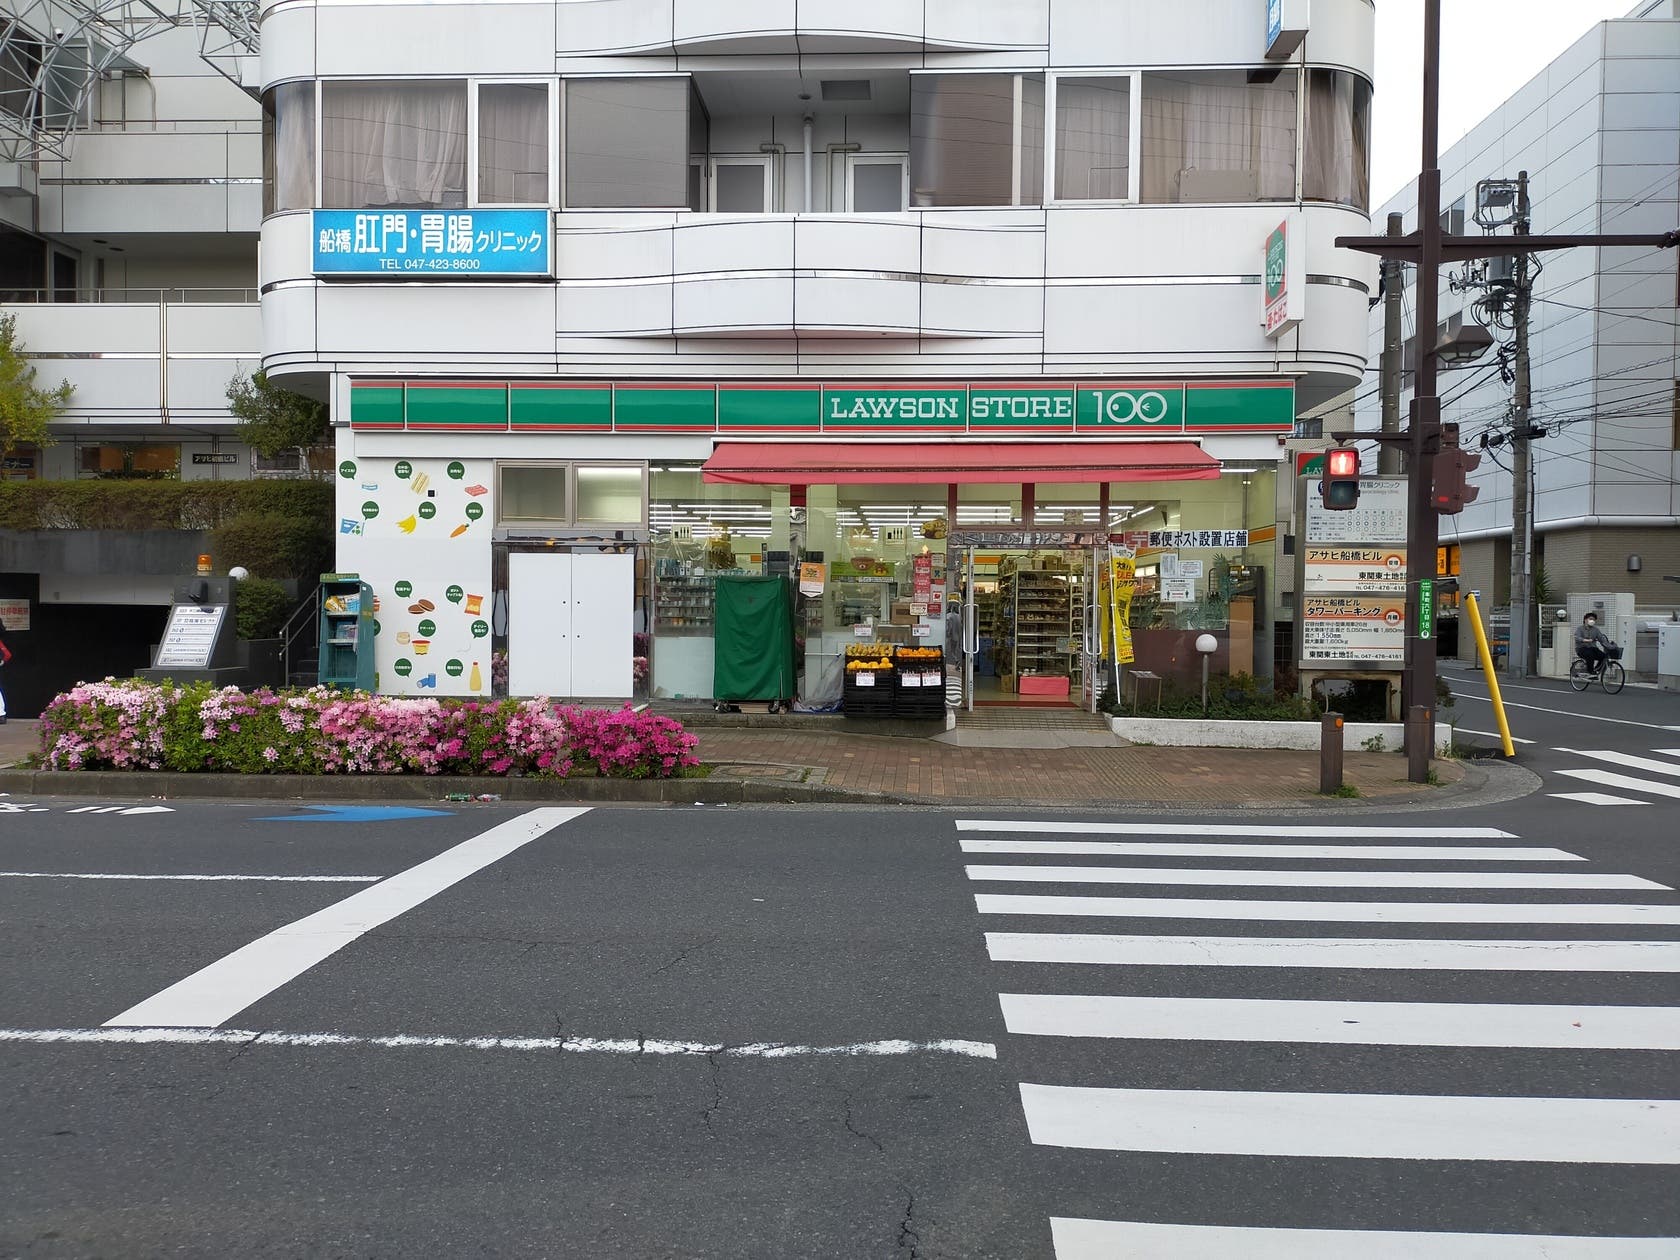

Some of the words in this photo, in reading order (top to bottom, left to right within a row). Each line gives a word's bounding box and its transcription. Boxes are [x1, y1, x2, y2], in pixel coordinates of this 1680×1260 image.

[319, 214, 542, 254] 船橋肛門・胃腸クリニック
[380, 259, 401, 269] TEL
[405, 259, 480, 269] 047-423-8600
[831, 397, 959, 418] LAWSON
[972, 397, 1072, 418] STORE
[1093, 392, 1168, 423] 100
[1149, 531, 1247, 547] 郵便ポスト設置店舗
[1309, 550, 1382, 561] アサヒ船橋ビル
[1307, 599, 1361, 607] アサヒ船橋ビル
[1307, 607, 1382, 617] タワーパーキング
